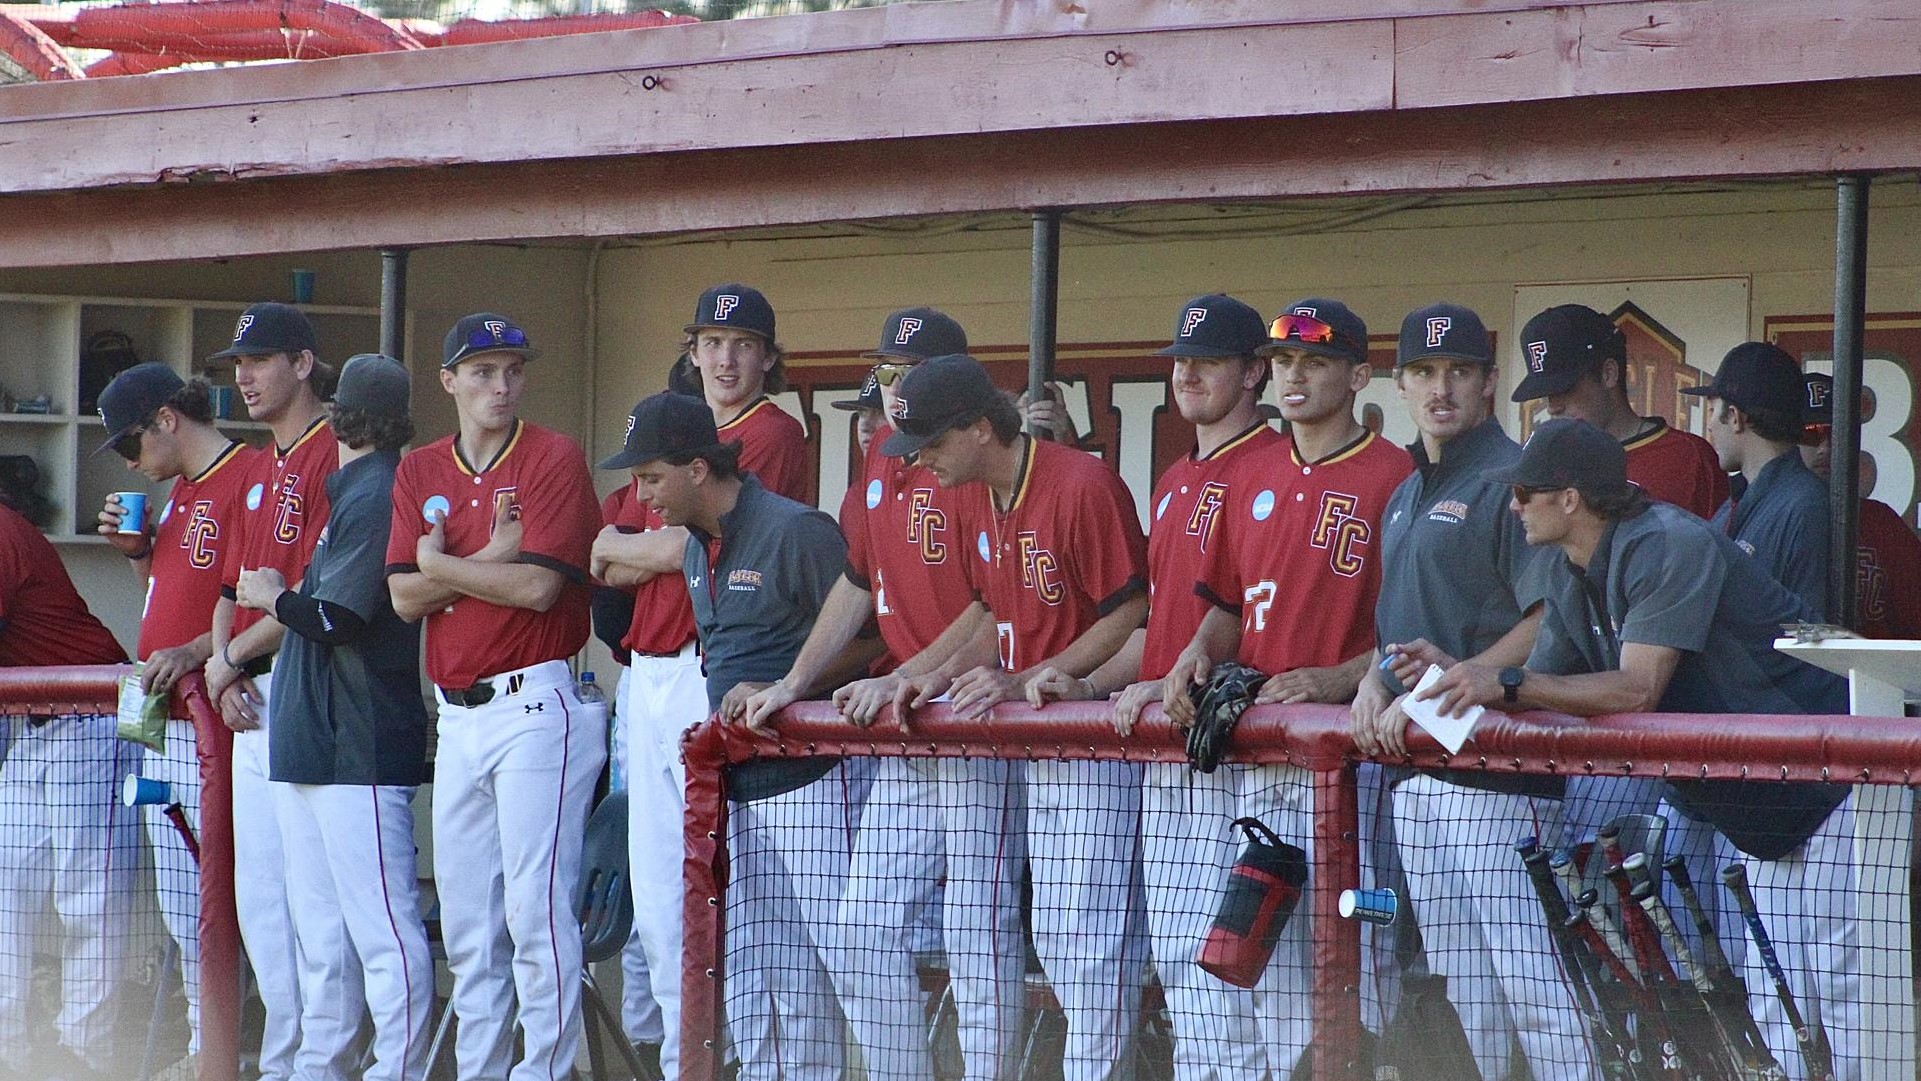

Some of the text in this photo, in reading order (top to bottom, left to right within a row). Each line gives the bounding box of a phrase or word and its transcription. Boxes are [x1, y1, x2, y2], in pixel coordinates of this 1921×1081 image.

[714, 295, 739, 321] F
[1181, 307, 1208, 337] F
[234, 314, 254, 342] F
[895, 317, 922, 344] F
[1427, 317, 1451, 348] F
[1528, 340, 1548, 372] F
[1807, 381, 1830, 407] F
[906, 488, 947, 564] FC
[1429, 514, 1457, 523] BASEBALL
[180, 501, 218, 569] FC
[1311, 491, 1371, 577] FC
[1018, 530, 1065, 606] FC
